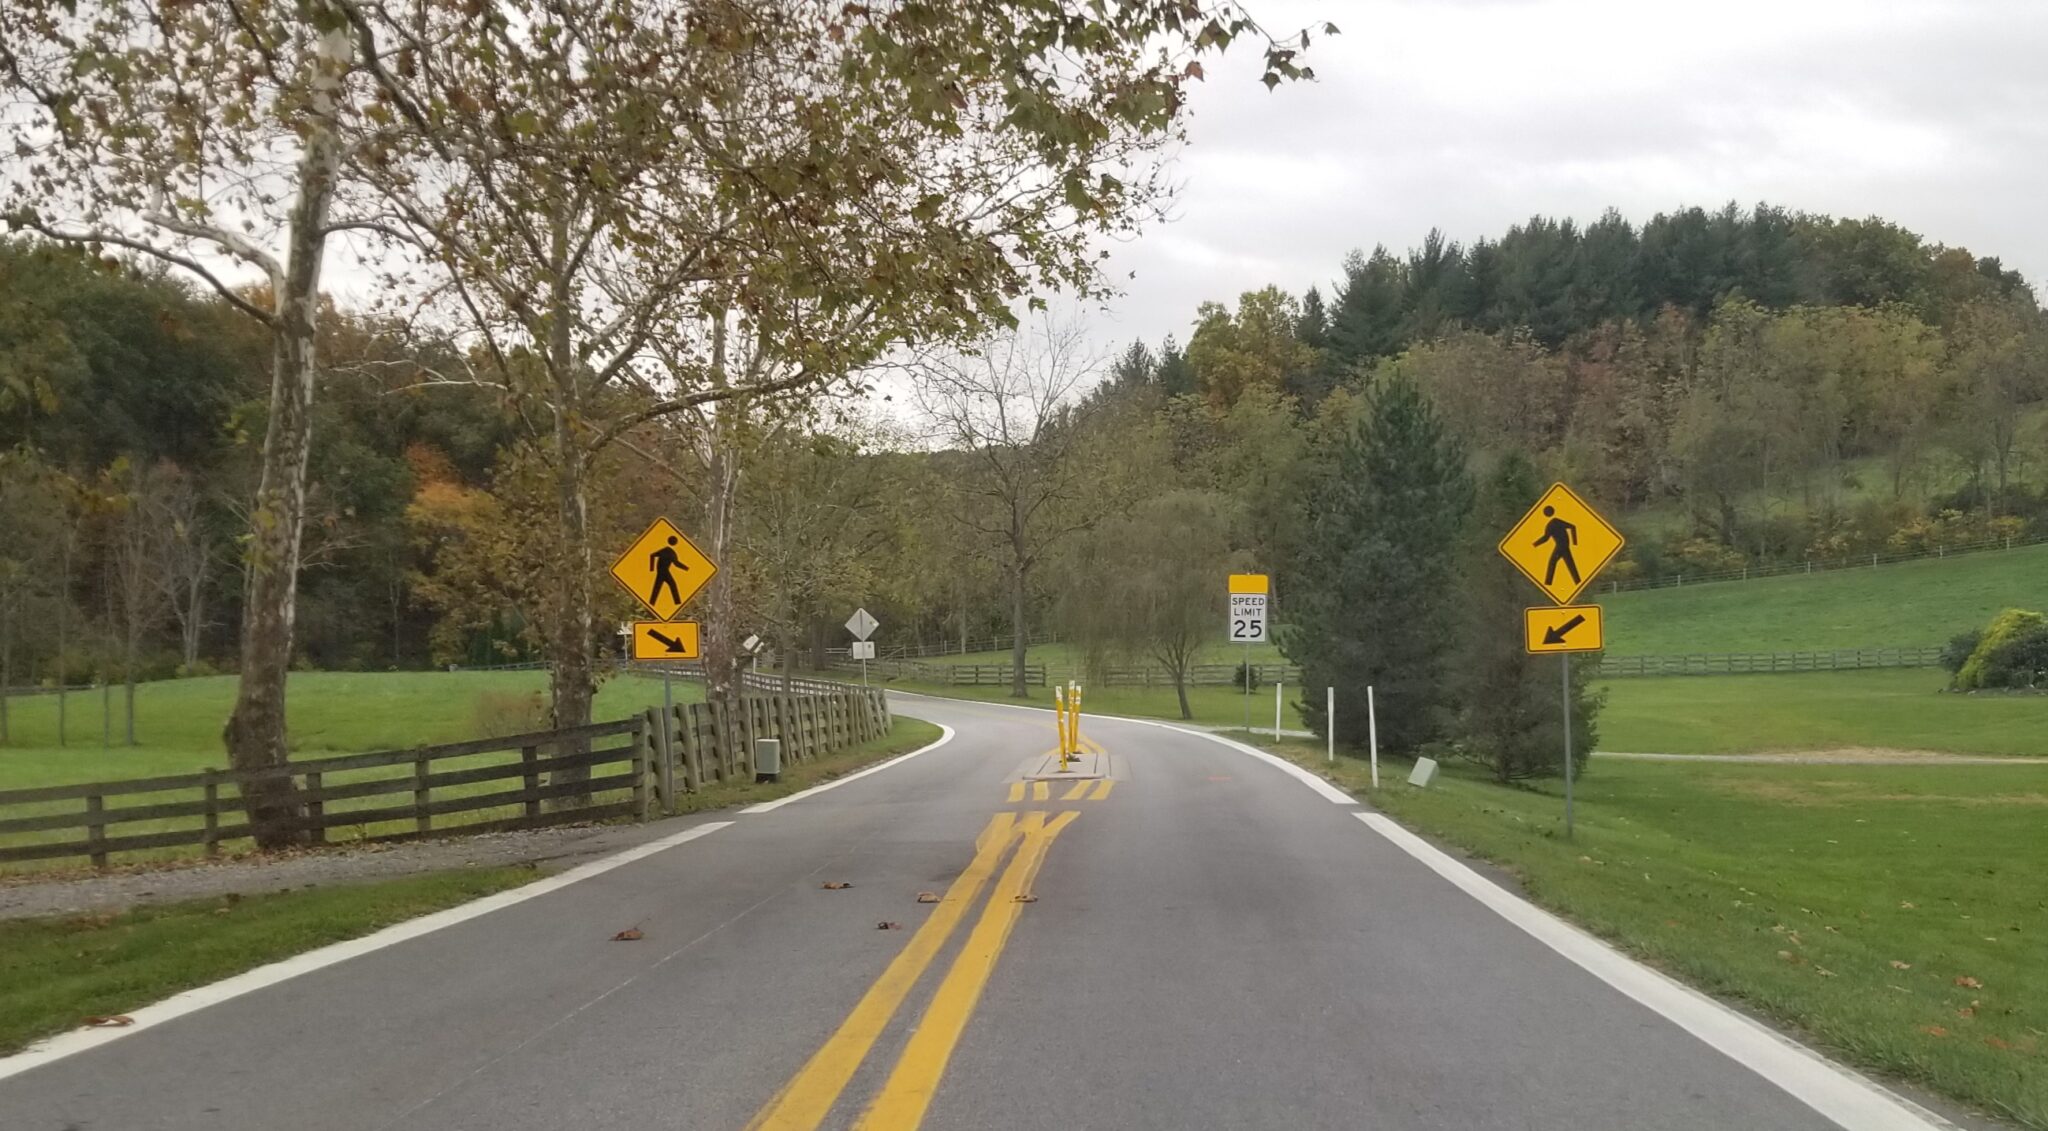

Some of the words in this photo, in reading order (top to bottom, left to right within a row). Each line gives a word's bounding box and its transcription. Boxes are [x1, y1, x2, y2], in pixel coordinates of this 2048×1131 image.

[1232, 597, 1265, 606] SPEED
[1234, 608, 1262, 616] LIMIT
[1234, 620, 1262, 638] 25
